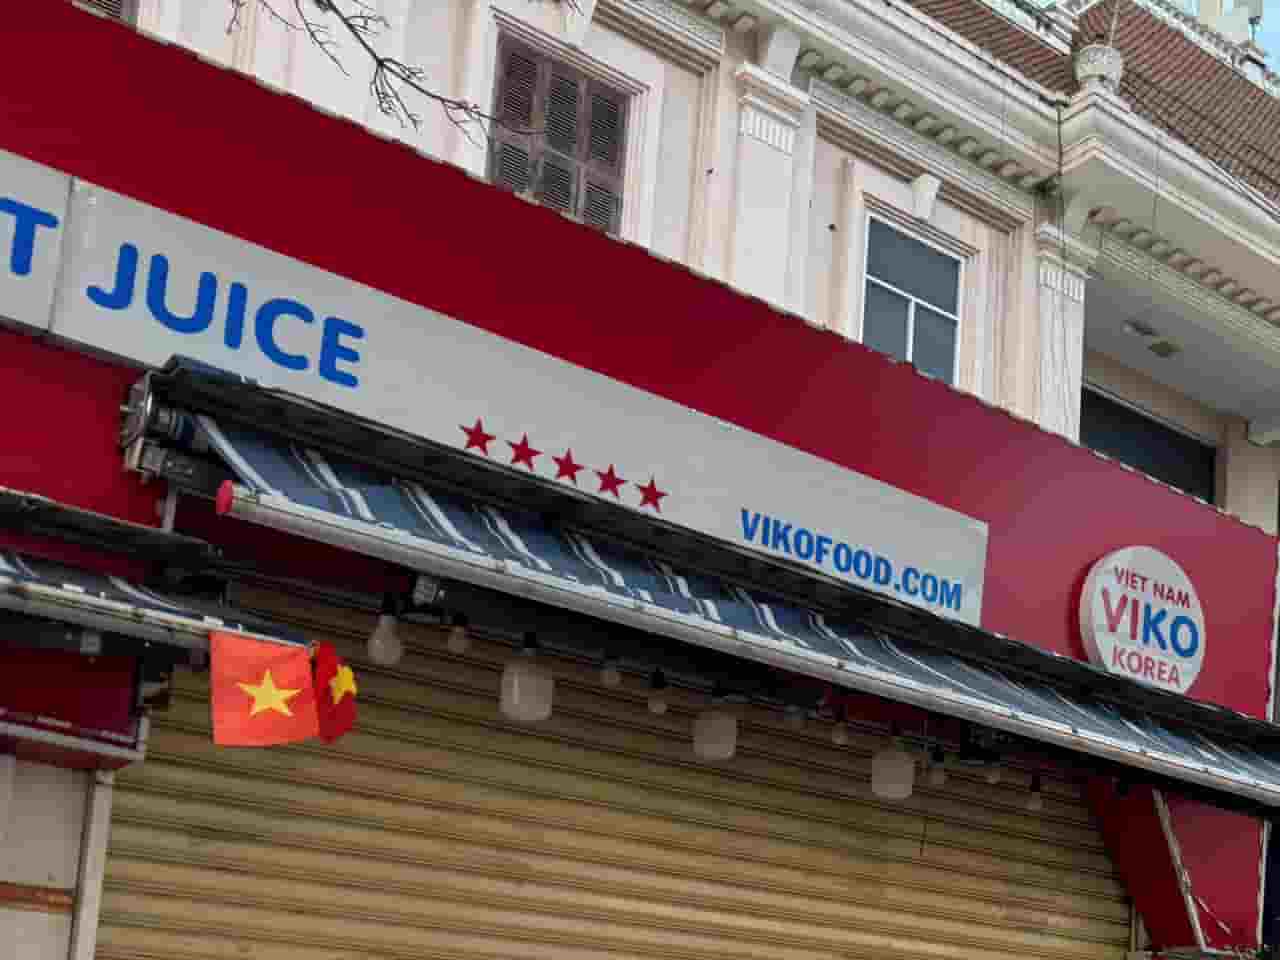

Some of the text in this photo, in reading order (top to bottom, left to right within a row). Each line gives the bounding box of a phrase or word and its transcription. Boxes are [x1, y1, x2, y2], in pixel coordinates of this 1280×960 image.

[86, 243, 365, 388] JUICE
[741, 508, 963, 612] VIKOFOOD.COM
[1114, 565, 1191, 609] VIET NAM
[1101, 587, 1199, 659] VIKO
[1112, 645, 1181, 689] KOREA
